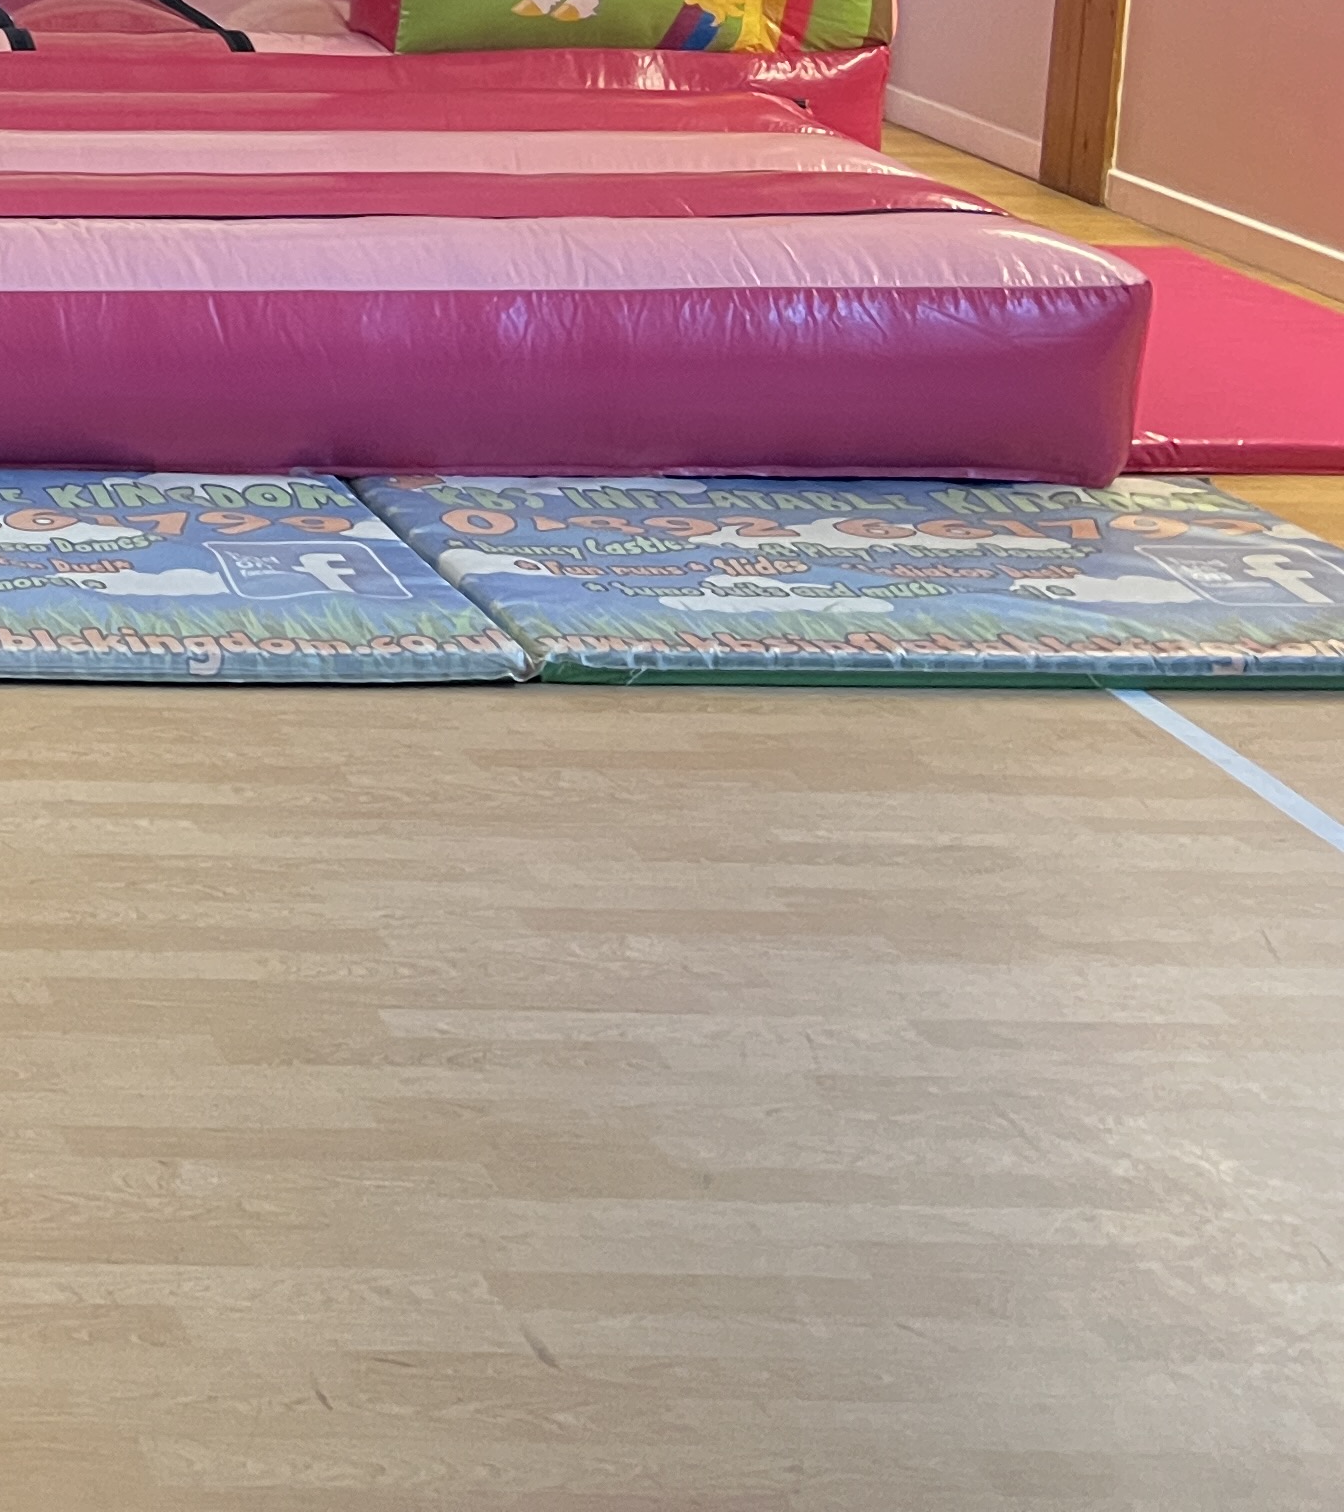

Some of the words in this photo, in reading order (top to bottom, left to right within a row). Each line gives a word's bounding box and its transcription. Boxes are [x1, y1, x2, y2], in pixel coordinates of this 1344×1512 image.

[44, 481, 356, 509] KINGDOM
[558, 486, 928, 512] INFLATABLE
[608, 563, 688, 576] runs
[713, 555, 810, 576] Slides
[790, 580, 861, 598] and
[861, 580, 952, 599] much
